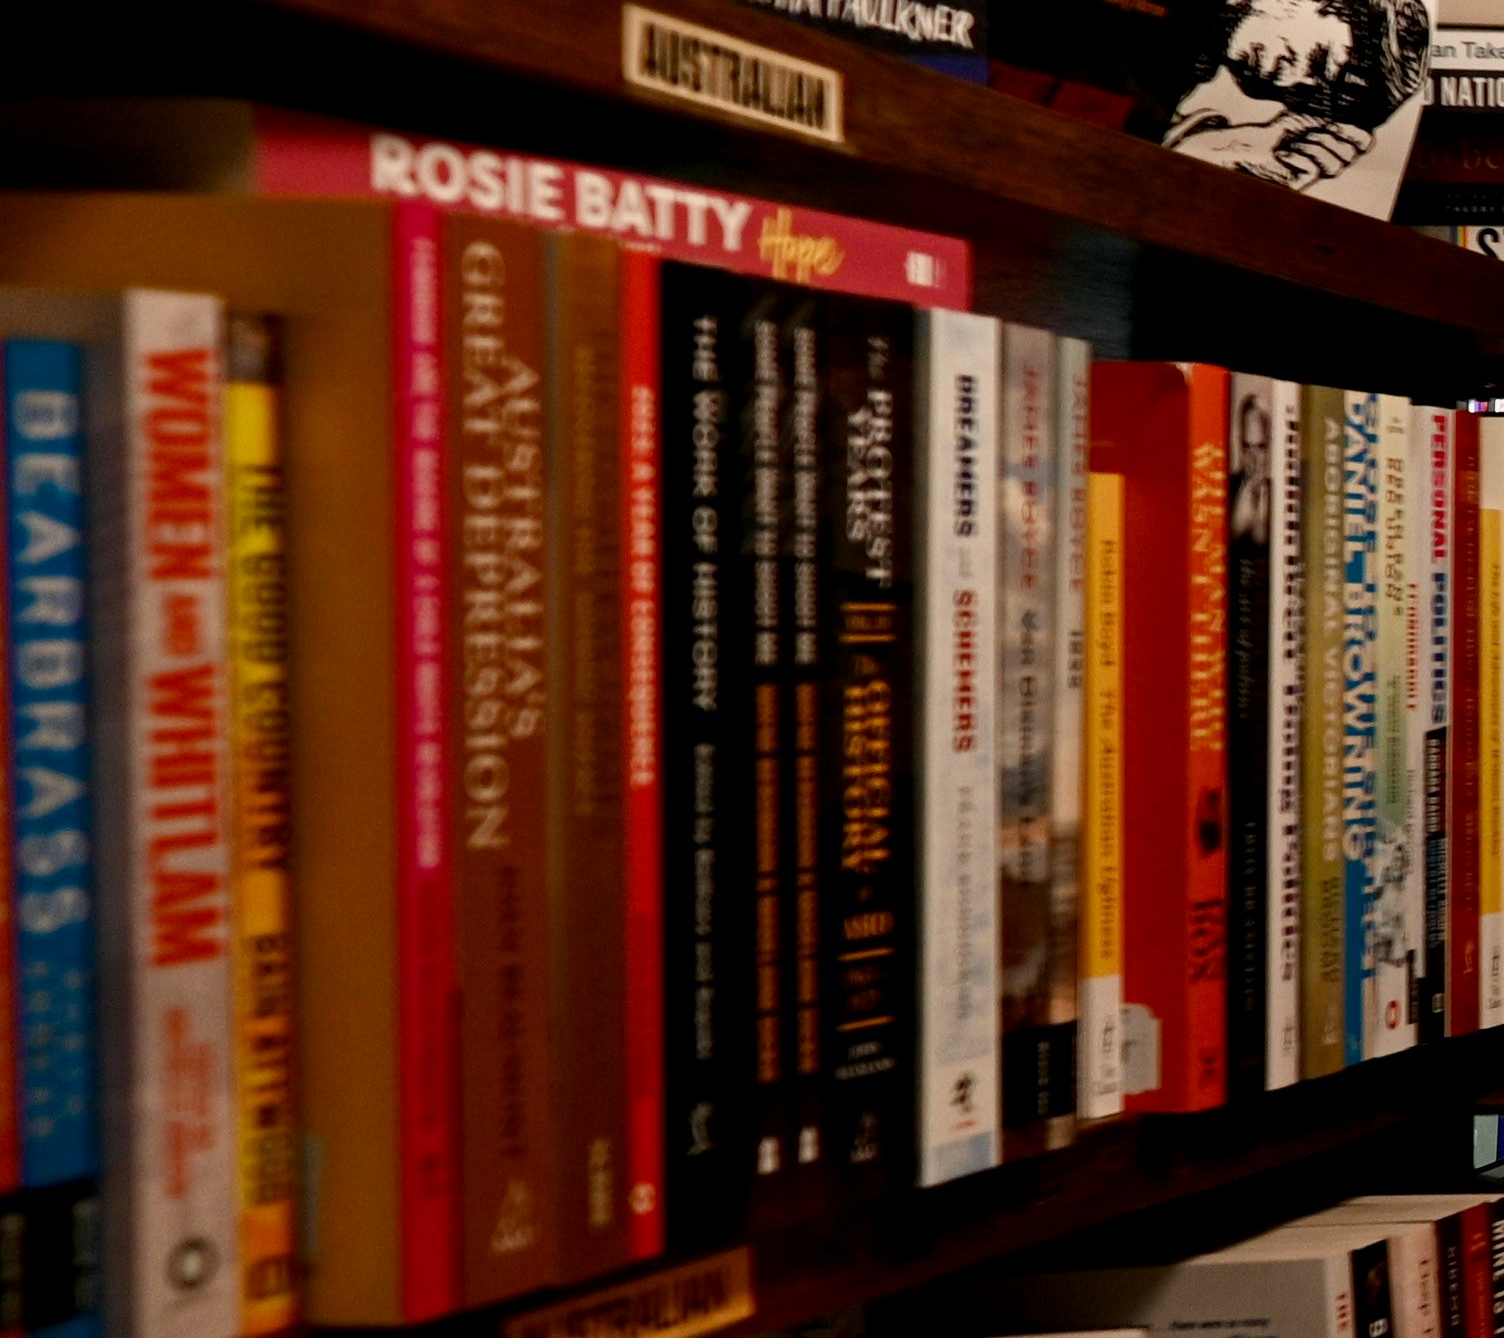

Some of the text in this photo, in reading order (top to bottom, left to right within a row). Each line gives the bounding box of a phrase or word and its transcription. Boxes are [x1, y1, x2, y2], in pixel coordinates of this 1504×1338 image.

[642, 22, 828, 127] AUSTRALIAN
[369, 132, 752, 253] ROSIE BATTY
[141, 348, 214, 583] WOMEN
[11, 386, 91, 939] BEARBRASS
[142, 663, 224, 970] WHITLAM
